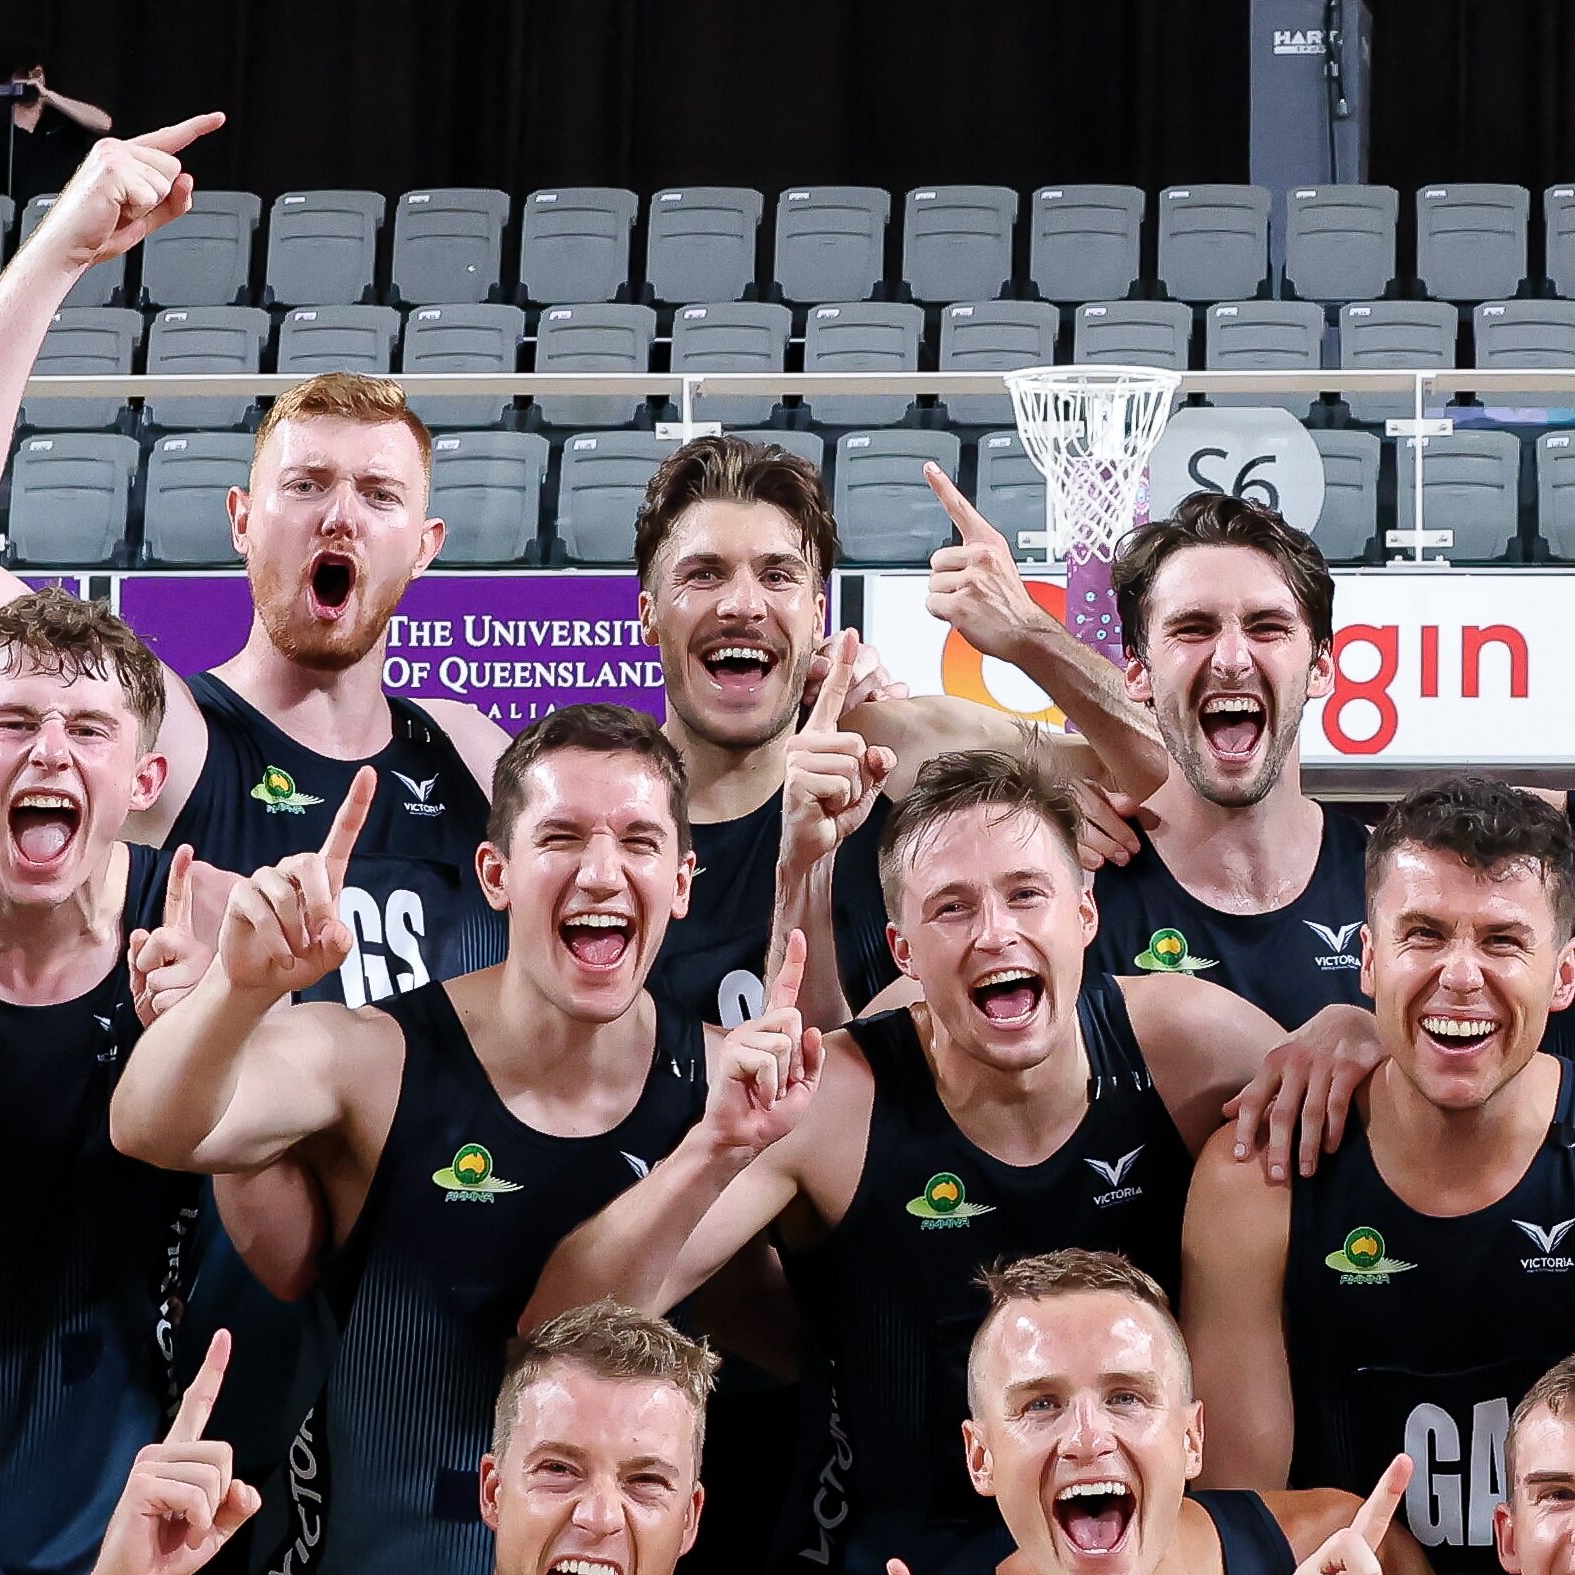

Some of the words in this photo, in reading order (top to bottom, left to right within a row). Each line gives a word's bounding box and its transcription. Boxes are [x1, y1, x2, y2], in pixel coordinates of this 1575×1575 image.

[1273, 30, 1325, 46] HAR
[1188, 447, 1280, 510] S6
[388, 614, 452, 648] THE
[463, 614, 643, 648] UNIVERSIT
[382, 656, 429, 690] OF
[439, 656, 664, 695] QUEENSLAND
[1322, 624, 1529, 754] gin
[1314, 954, 1361, 967] VICTORA
[1093, 1186, 1143, 1205] VICTORIA
[1520, 1257, 1575, 1269] VICTORIA
[1404, 1397, 1510, 1547] GA
